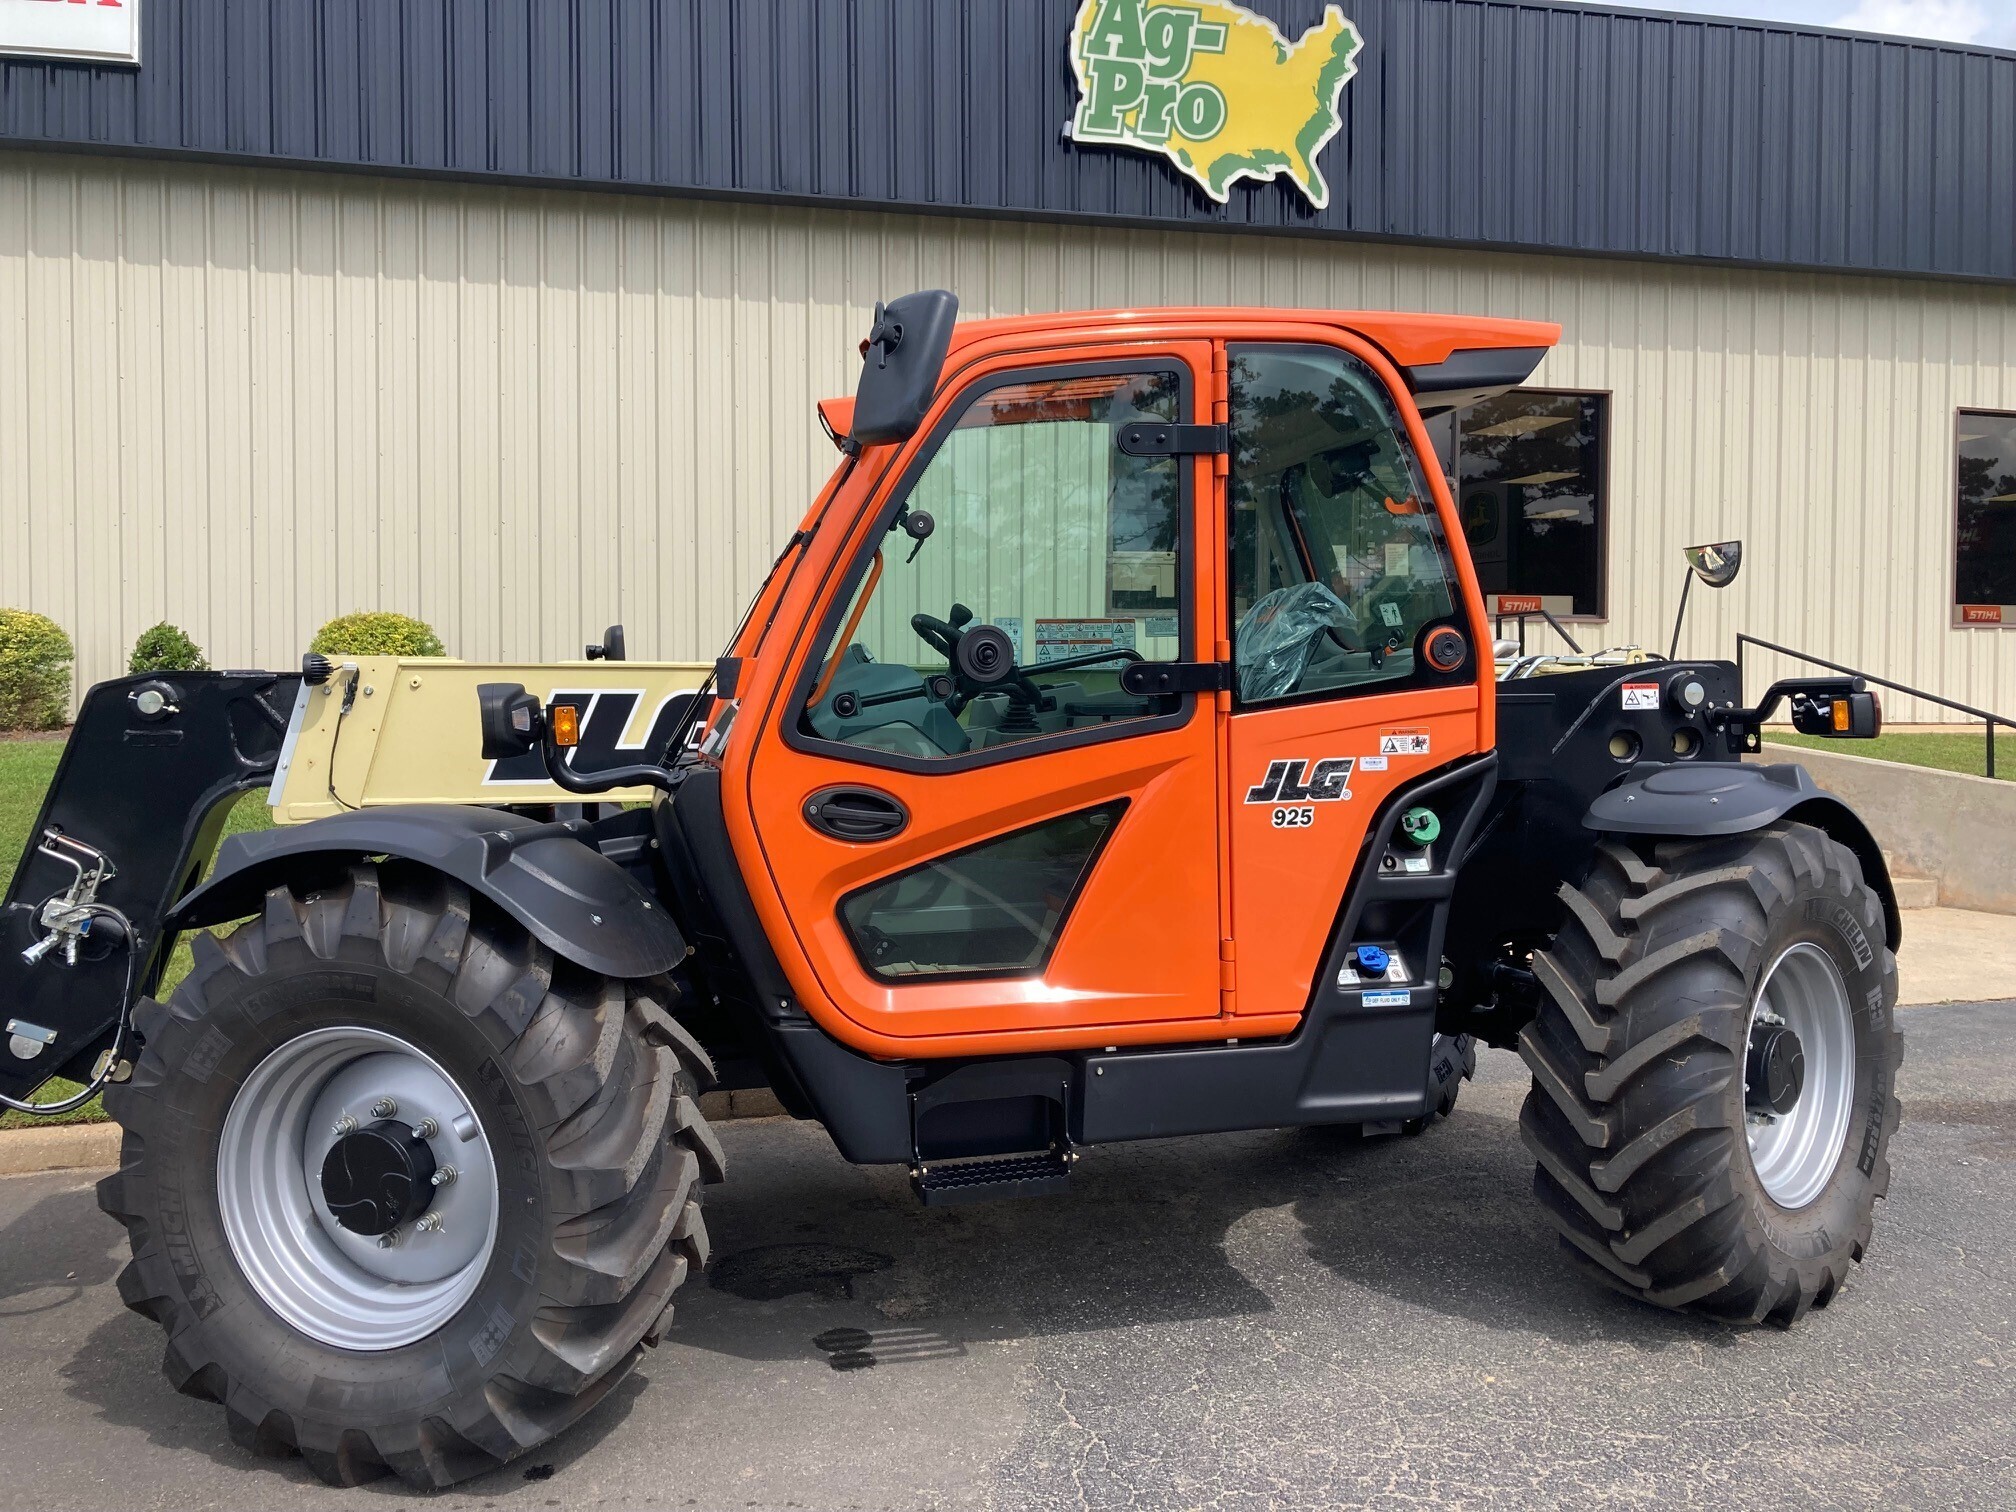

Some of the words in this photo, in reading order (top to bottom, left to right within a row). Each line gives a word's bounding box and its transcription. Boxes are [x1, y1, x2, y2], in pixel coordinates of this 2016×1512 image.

[1082, 0, 1227, 81] Ag-
[1082, 57, 1226, 140] Pro
[1503, 601, 1539, 611] STIHL
[1968, 610, 2000, 620] STIHL
[1244, 757, 1356, 804] JLG
[1272, 805, 1314, 828] 925
